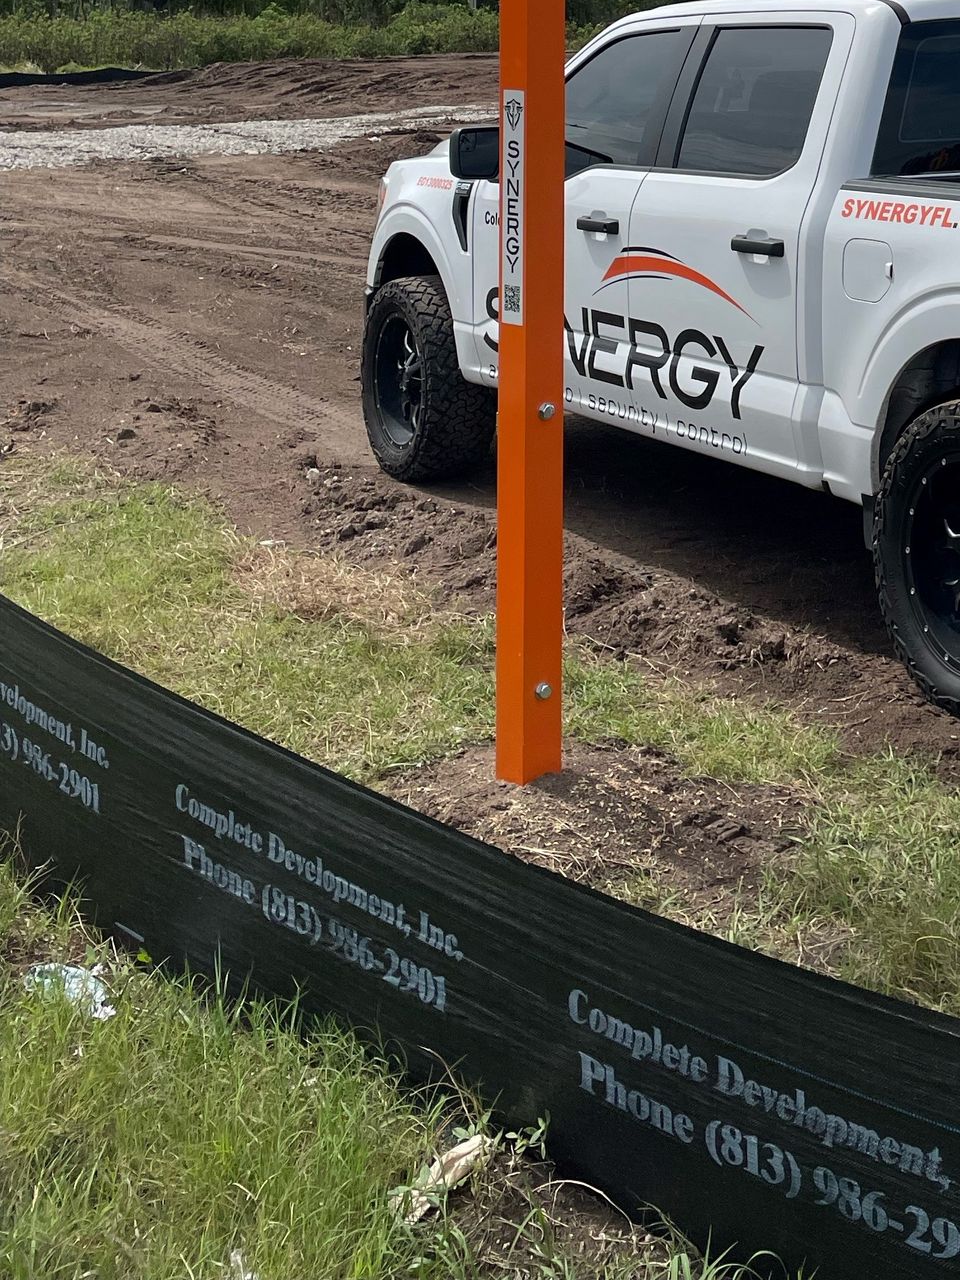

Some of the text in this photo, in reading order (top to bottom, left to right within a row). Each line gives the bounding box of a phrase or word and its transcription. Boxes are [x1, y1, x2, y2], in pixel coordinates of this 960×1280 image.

[506, 140, 520, 274] SYNERGY
[588, 393, 659, 435] security
[675, 418, 749, 457] control
[23, 737, 100, 815] 986-2901
[80, 727, 110, 769] Inc.
[175, 783, 466, 963] Complete Development, Inc.
[182, 835, 447, 1014] Phone (813) 986-2901
[568, 988, 709, 1083] Complete
[714, 1054, 952, 1194] Development,
[578, 1050, 694, 1144] Phone
[704, 1119, 803, 1200] (813)
